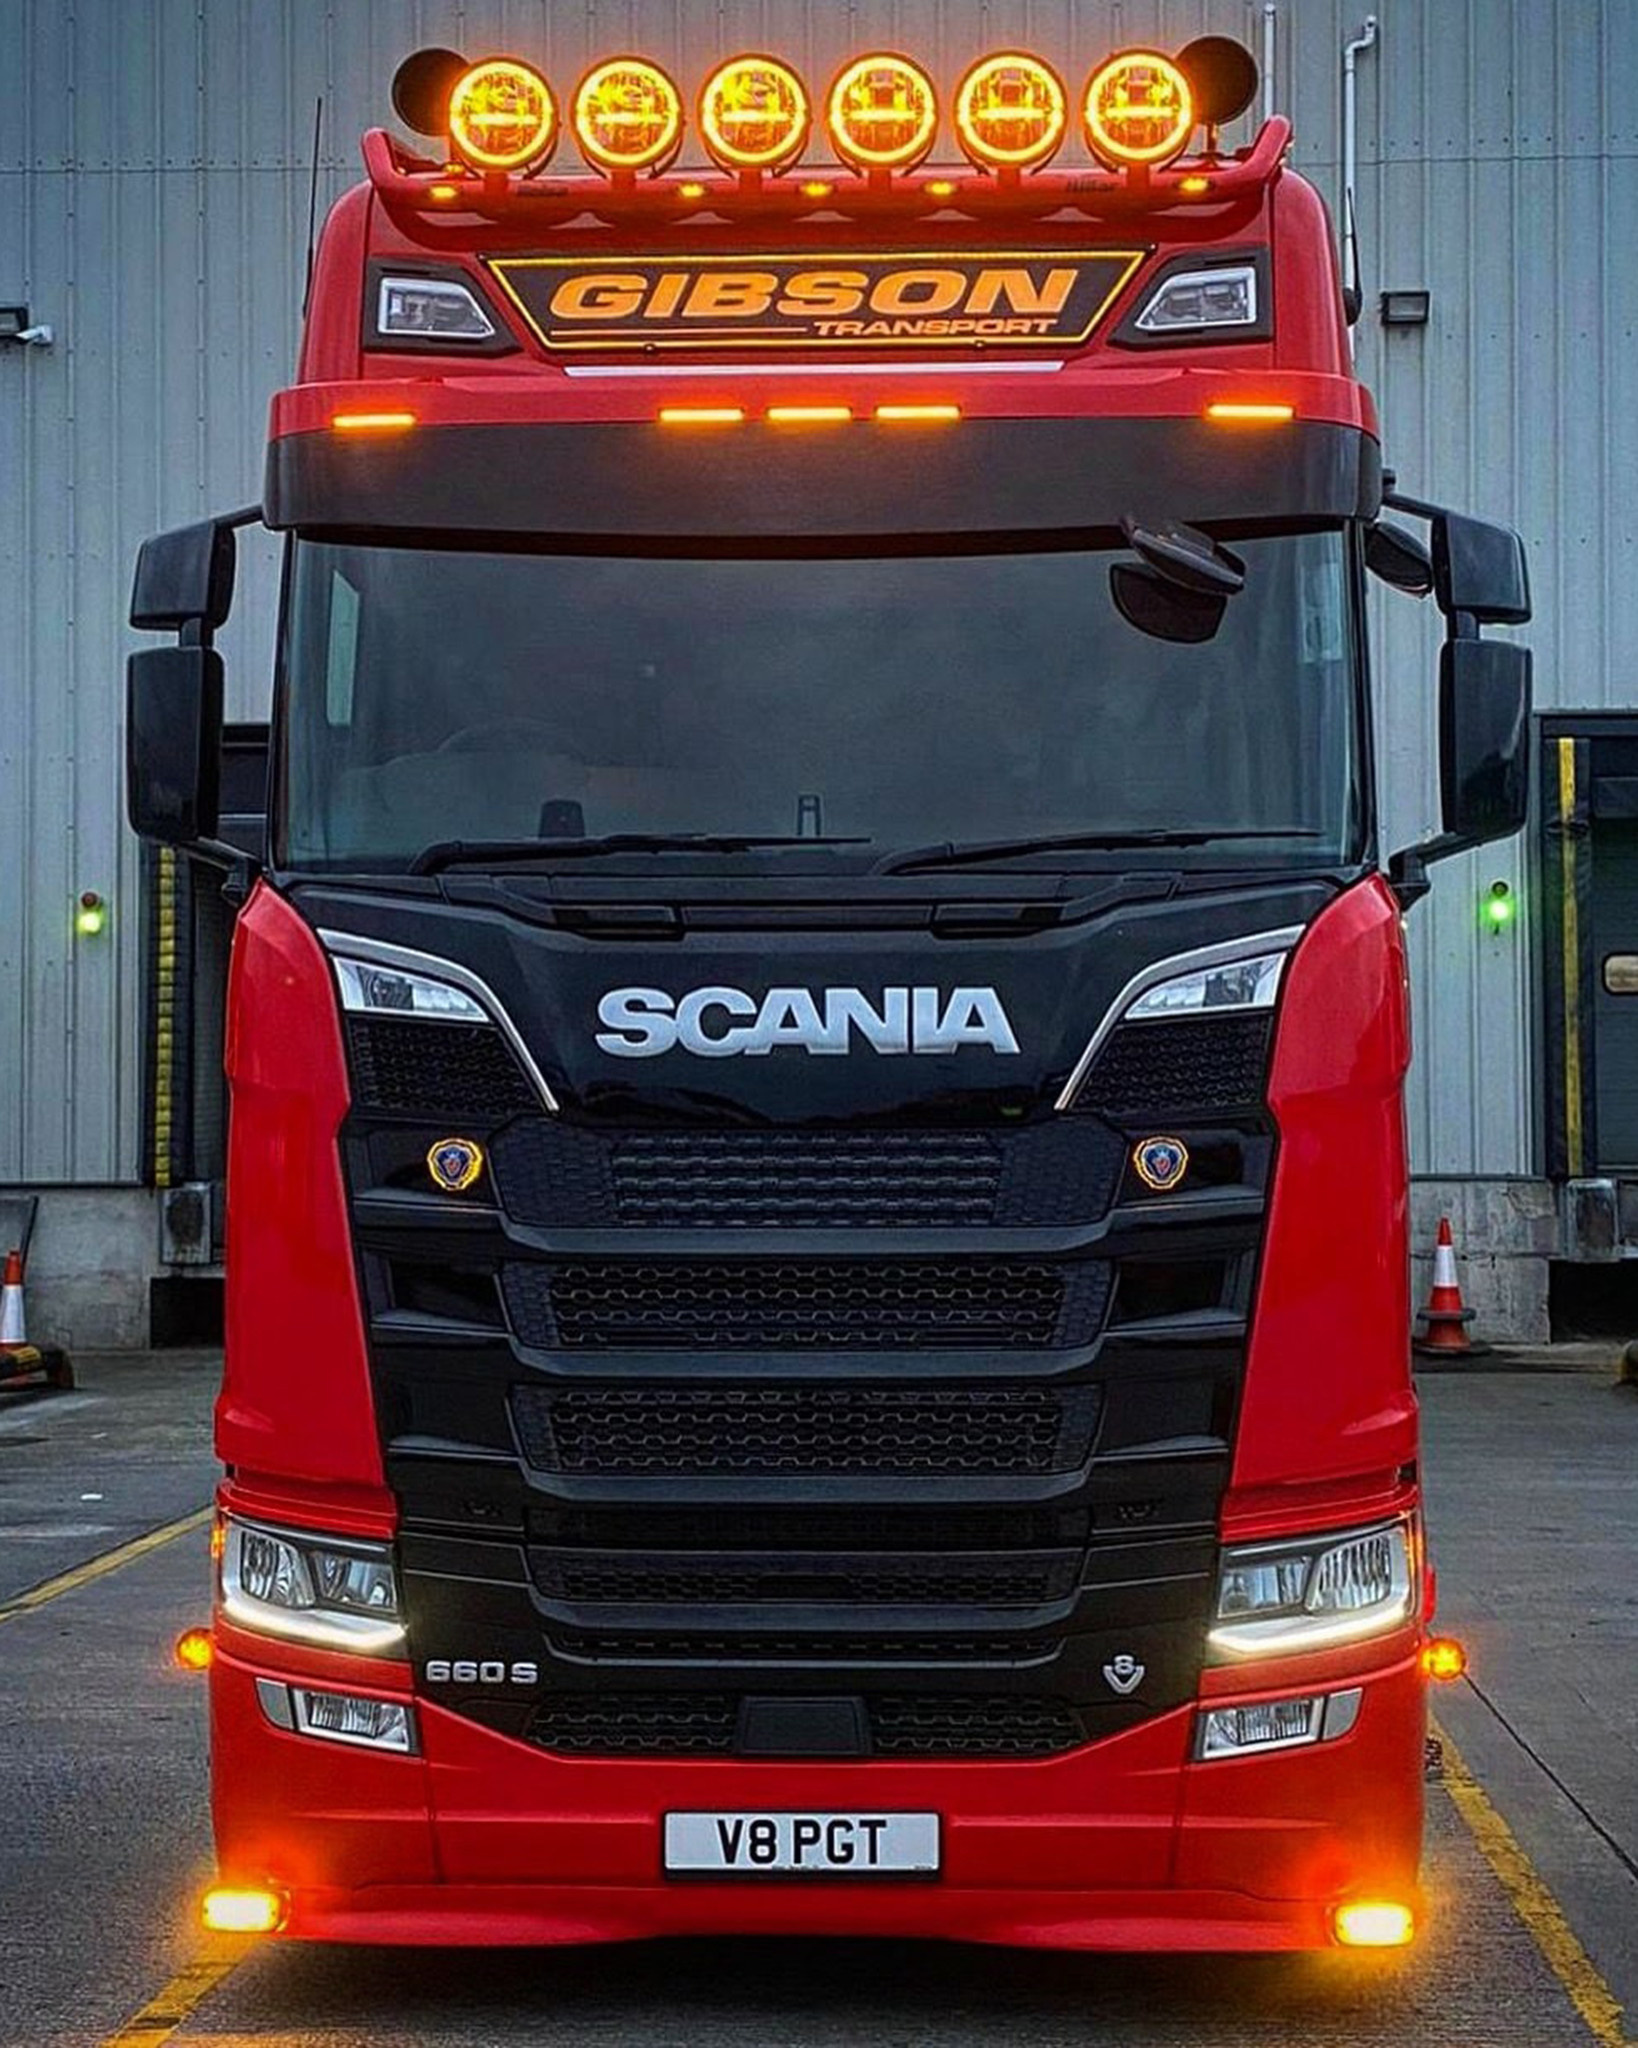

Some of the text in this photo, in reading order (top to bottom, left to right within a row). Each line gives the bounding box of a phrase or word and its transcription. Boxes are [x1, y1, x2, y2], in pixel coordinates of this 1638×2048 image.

[549, 268, 1079, 319] GIBSON
[813, 318, 1058, 336] TRANSPORT
[595, 986, 1021, 1058] SCANIA
[426, 1660, 538, 1684] 660 S
[717, 1819, 887, 1865] V8 PGT
